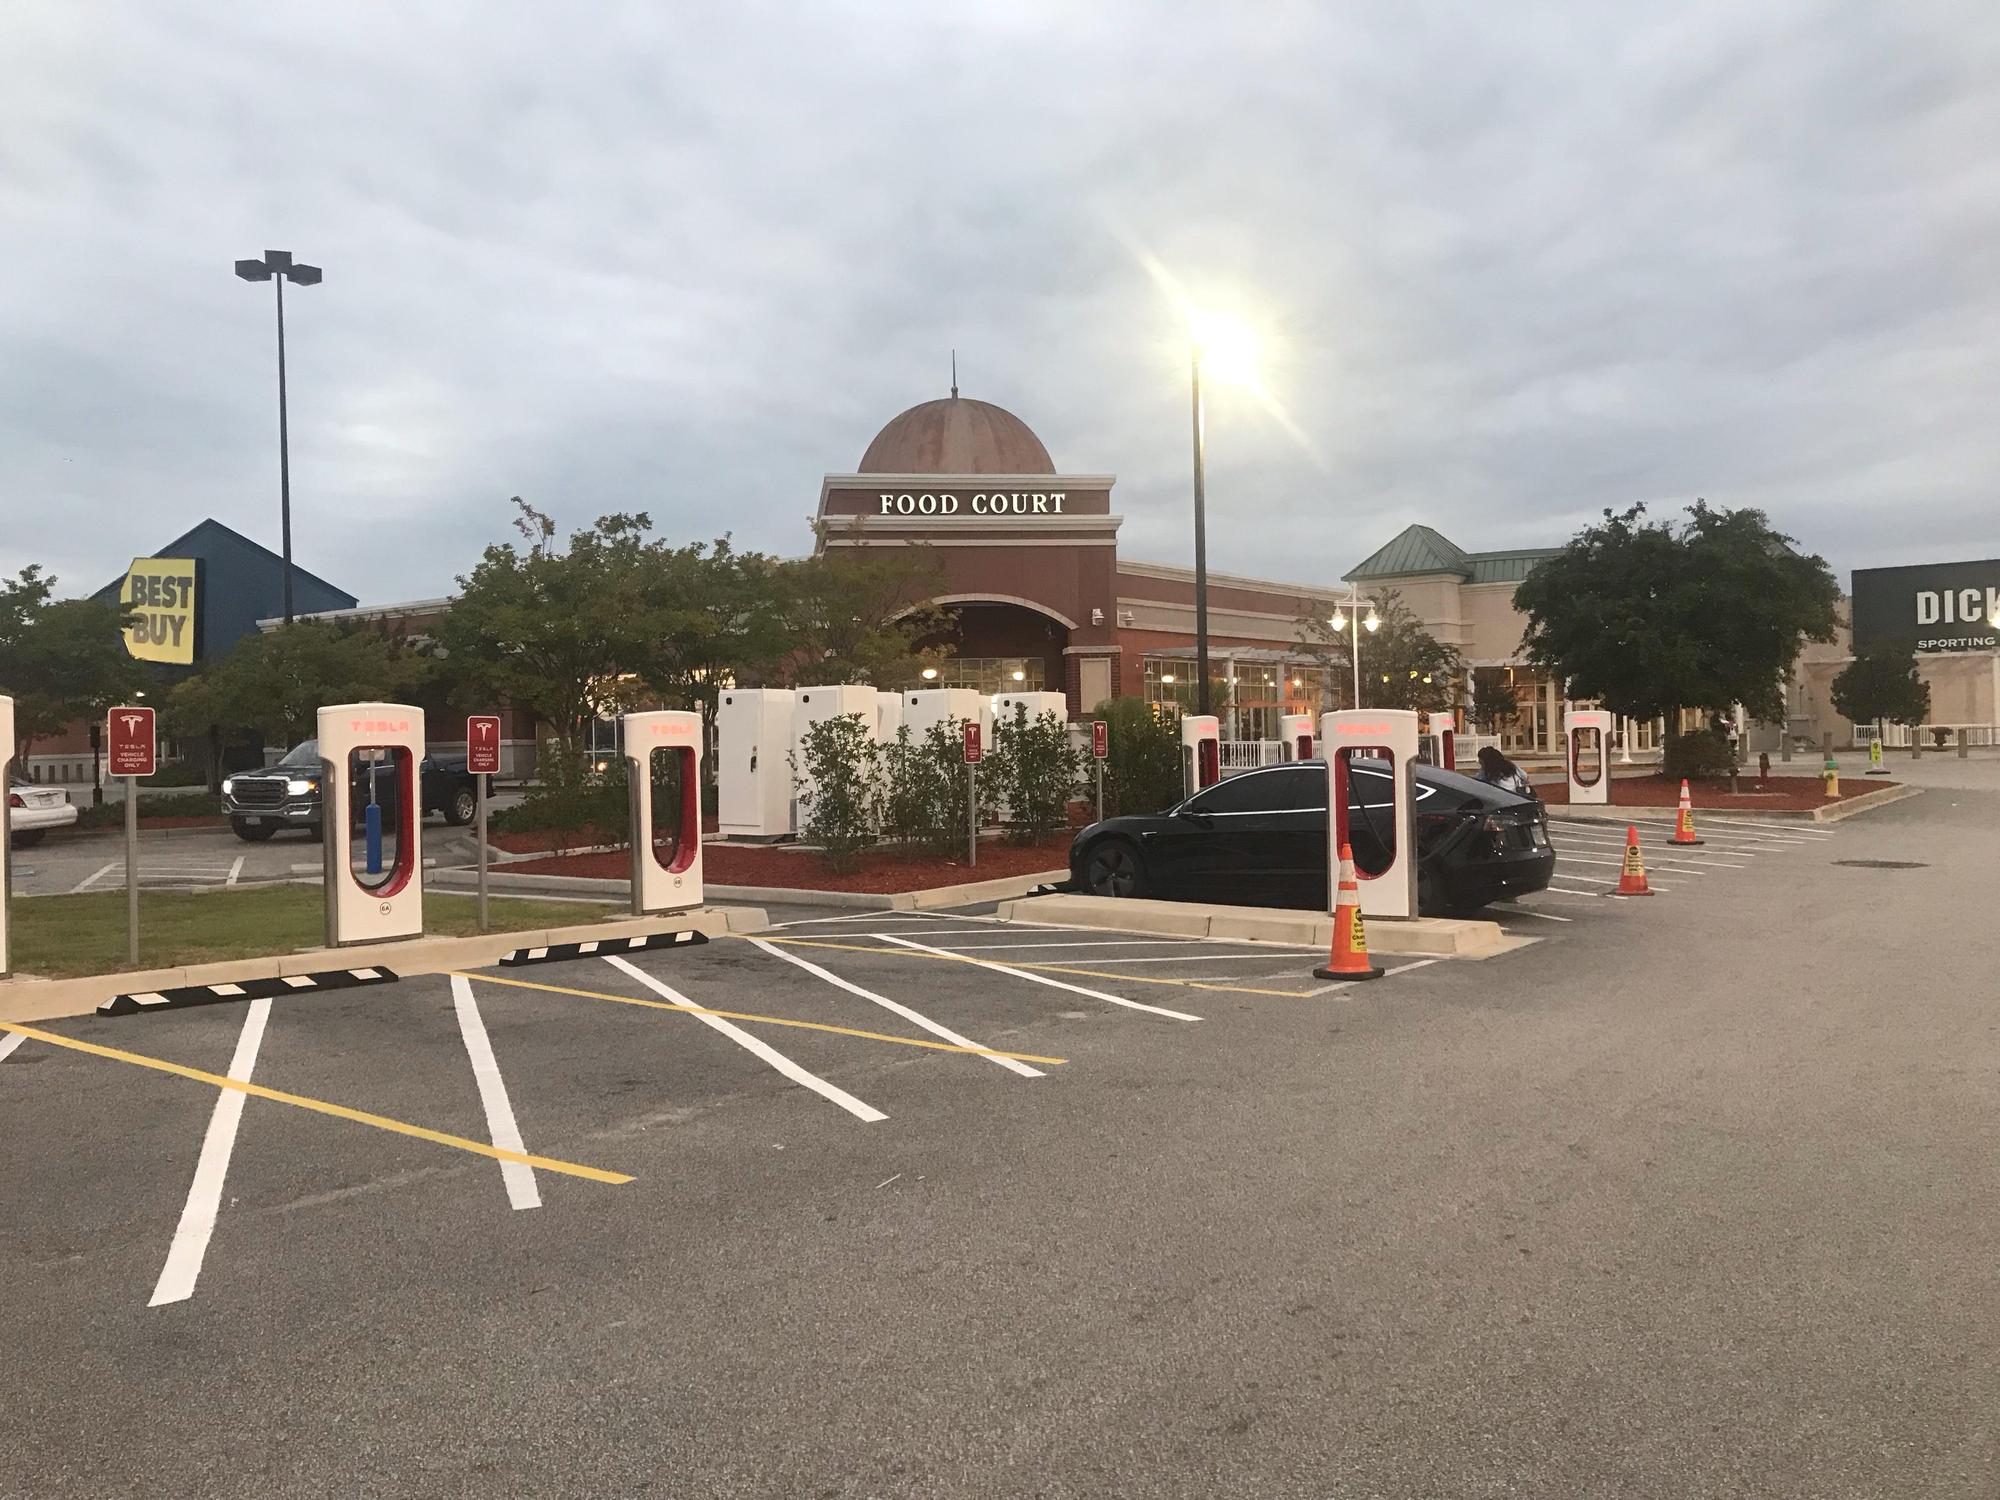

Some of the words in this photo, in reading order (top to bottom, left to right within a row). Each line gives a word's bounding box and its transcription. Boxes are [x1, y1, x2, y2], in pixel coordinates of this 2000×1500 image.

[880, 494, 958, 514] FOOD
[972, 493, 1066, 514] COURT
[131, 574, 193, 609] BEST
[133, 612, 187, 647] BUY
[1918, 637, 1996, 649] SPORTING
[350, 720, 410, 732] TESLA
